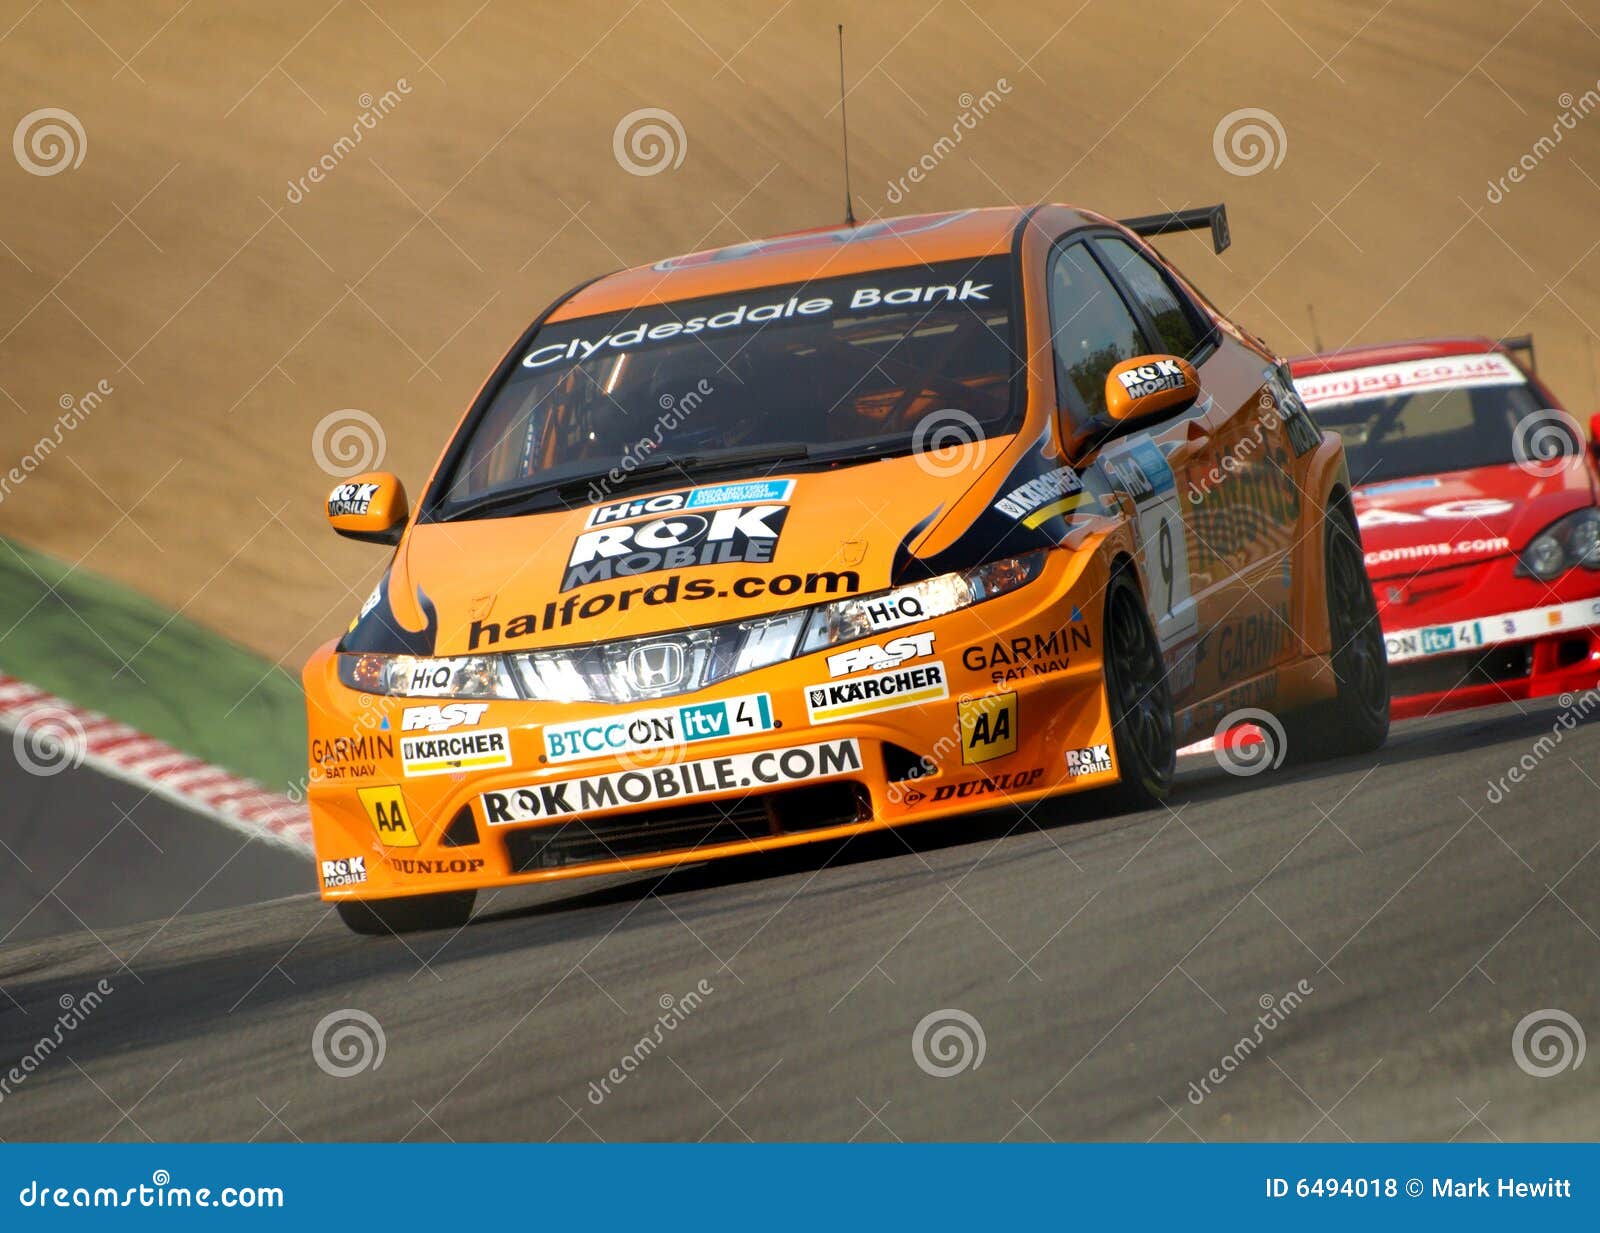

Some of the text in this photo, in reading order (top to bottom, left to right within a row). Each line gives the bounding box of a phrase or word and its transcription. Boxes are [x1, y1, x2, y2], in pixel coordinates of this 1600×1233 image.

[523, 280, 993, 369] Clydesdale Bank
[1118, 360, 1182, 388] ROK
[1128, 375, 1185, 400] MOBILE
[328, 483, 381, 501] ROK
[328, 500, 369, 517] MOBILE
[596, 494, 684, 523] HiQ
[569, 505, 786, 567] ROK
[563, 539, 774, 592] MOBILE
[468, 569, 861, 651] halfords.com
[868, 597, 924, 624] HiQ
[826, 631, 936, 678] FAST
[962, 624, 1092, 671] GARMIN
[411, 666, 451, 689] HiQ
[991, 658, 1070, 684] SAT NAV
[829, 666, 942, 705] KÄRCHER
[402, 703, 489, 731] FAST
[685, 708, 724, 736] itv
[736, 701, 754, 727] 4
[969, 707, 1010, 749] AA
[312, 735, 394, 763] GARMIN
[416, 733, 504, 758] KÄRCHER
[1066, 744, 1110, 766] ROK
[326, 765, 376, 779] SAT NAV
[1069, 760, 1112, 777] MOBILE
[930, 768, 1044, 802] DUNLOP
[375, 800, 406, 831] AA
[321, 856, 366, 877] ROK
[392, 858, 485, 874] DUNLOP
[324, 874, 368, 888] MOBILE
